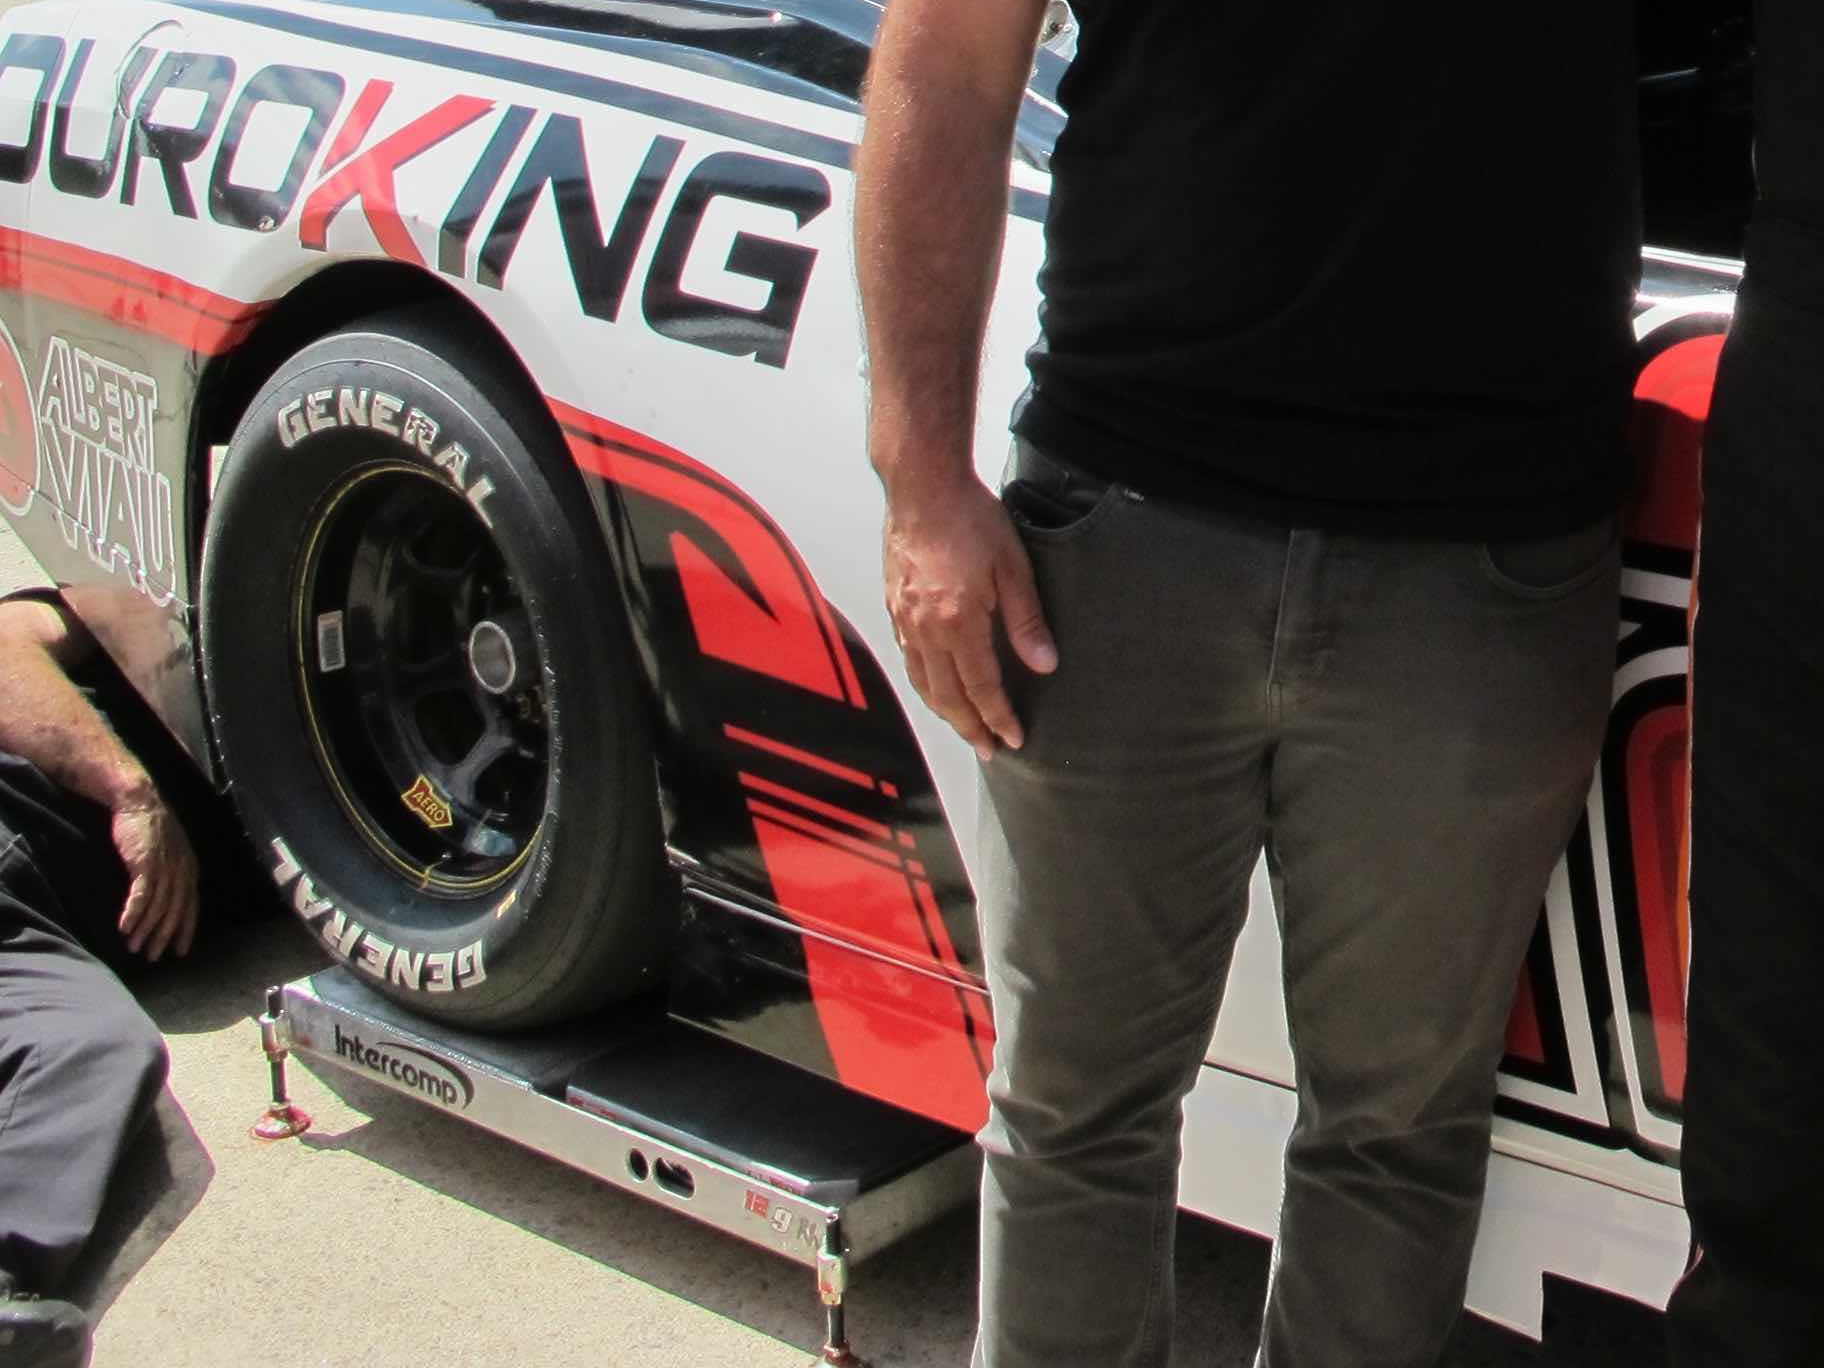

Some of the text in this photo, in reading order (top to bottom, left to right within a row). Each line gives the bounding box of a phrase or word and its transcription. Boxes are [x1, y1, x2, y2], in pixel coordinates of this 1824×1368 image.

[40, 336, 158, 474] ALBERT
[277, 387, 498, 529] GENERAL
[41, 414, 177, 607] VIAU
[411, 790, 445, 823] AERO
[269, 836, 488, 994] GENERAL
[335, 1023, 458, 1109] Intercomp
